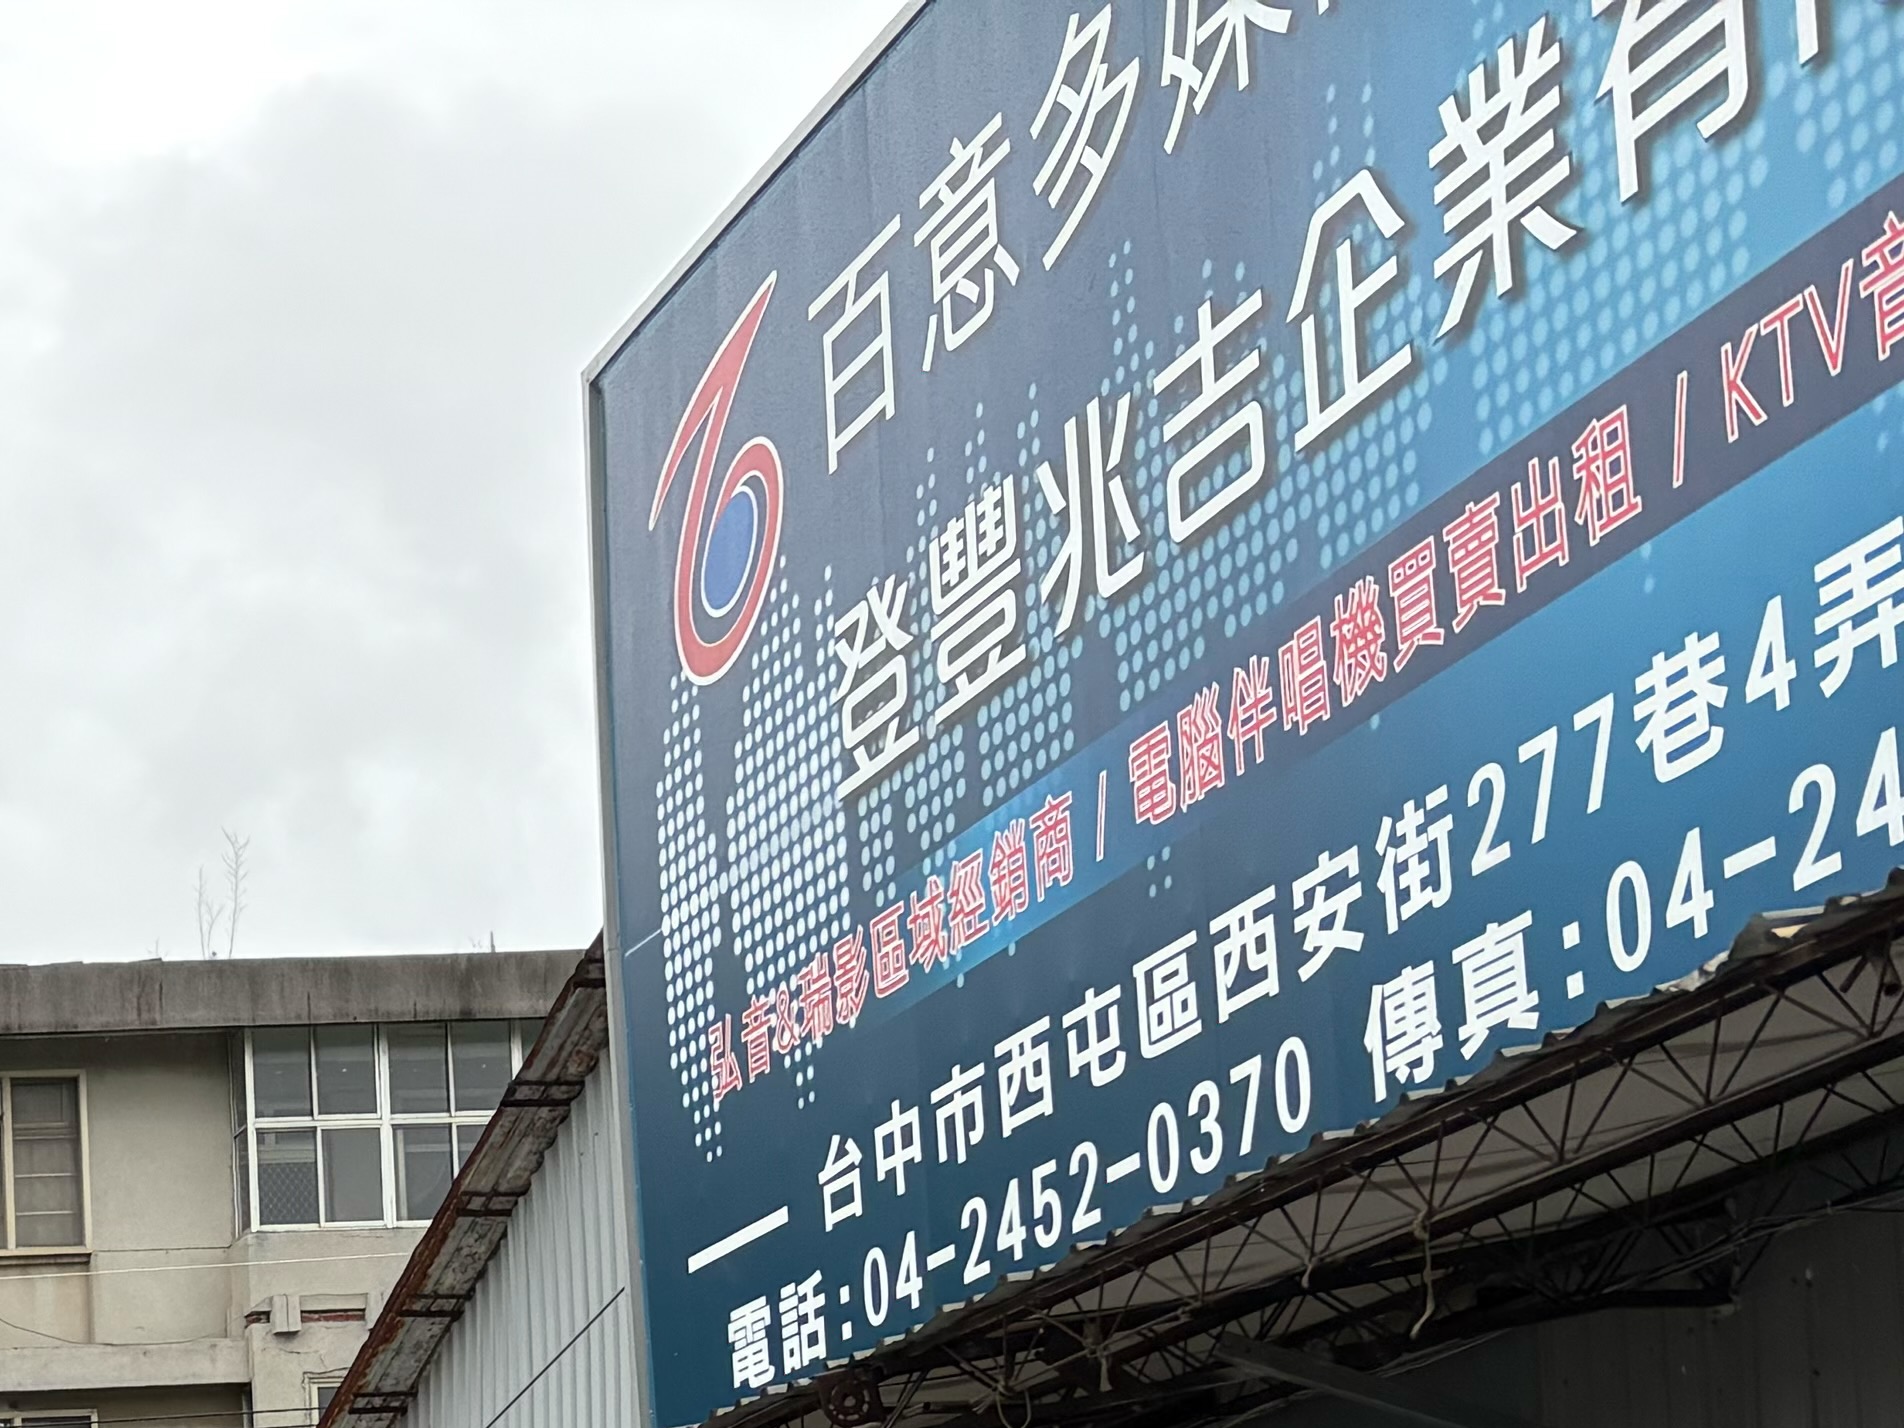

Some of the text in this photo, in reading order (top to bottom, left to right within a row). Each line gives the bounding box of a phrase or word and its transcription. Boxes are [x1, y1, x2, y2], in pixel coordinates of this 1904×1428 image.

[808, 0, 1330, 474] 百意多媒
[834, 0, 1818, 800] 登豐兆吉企業有
